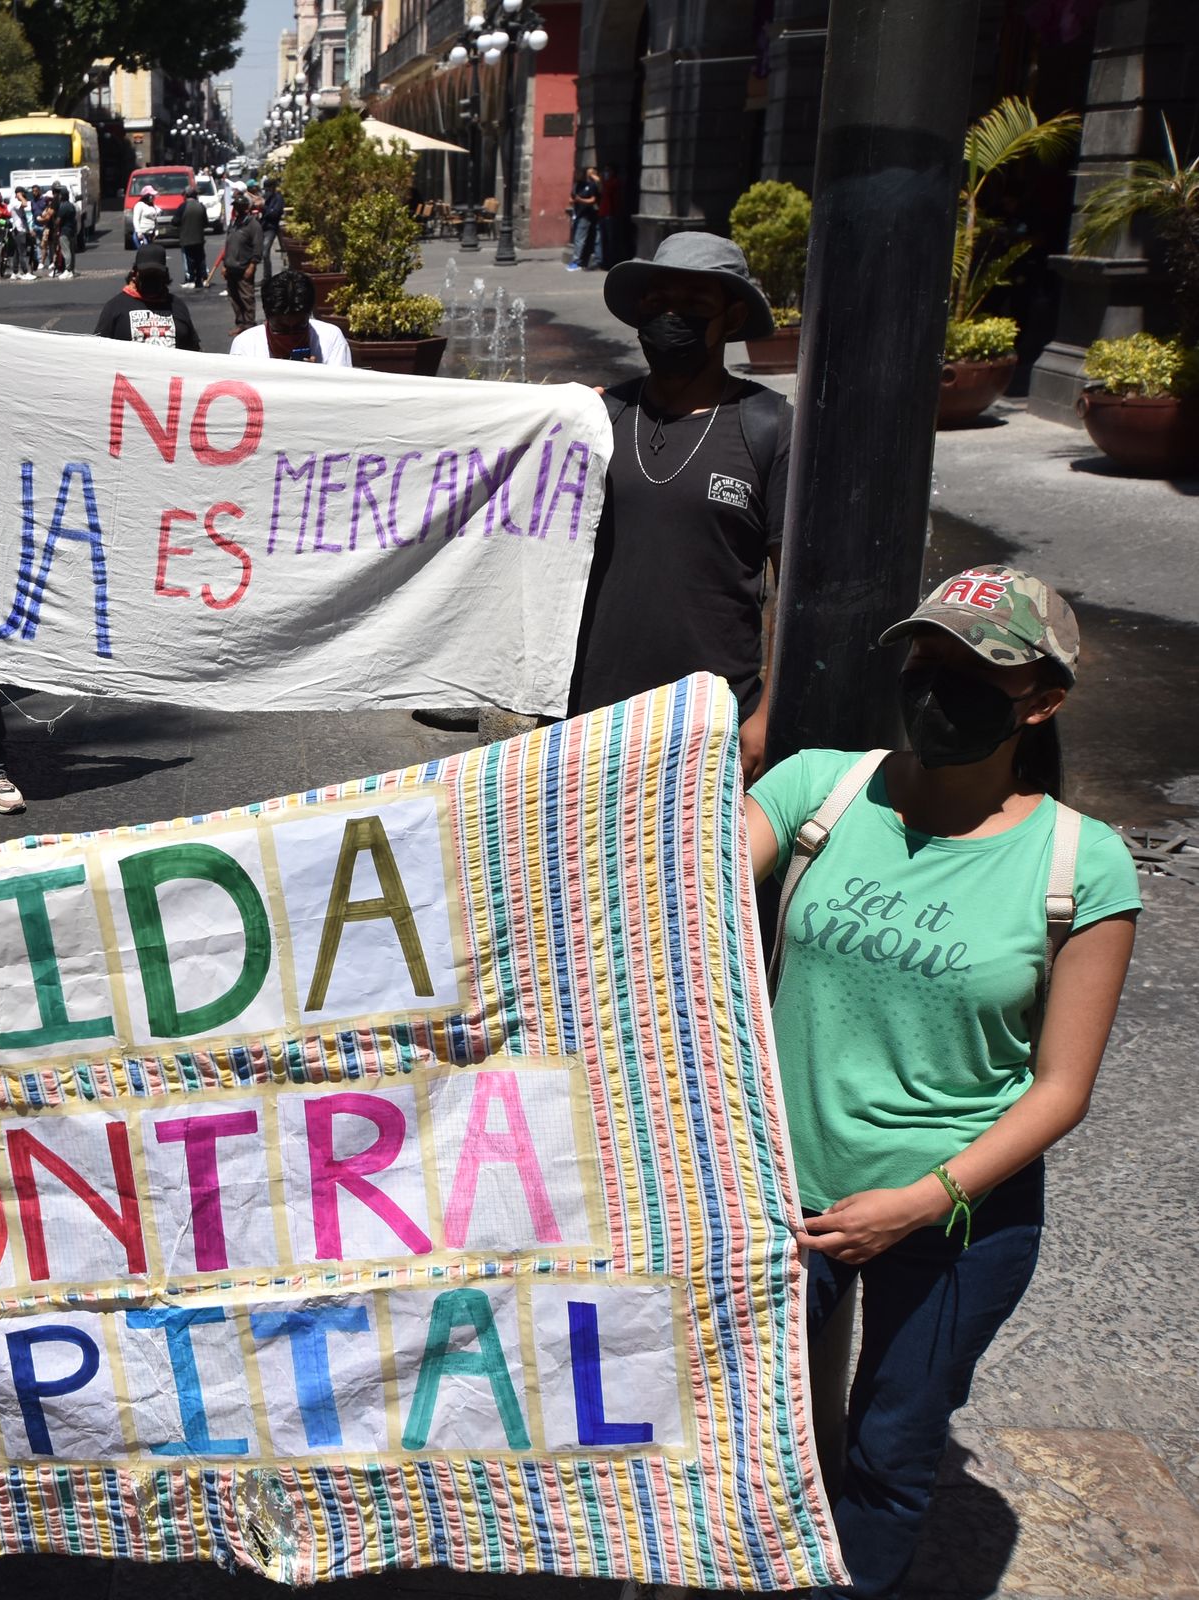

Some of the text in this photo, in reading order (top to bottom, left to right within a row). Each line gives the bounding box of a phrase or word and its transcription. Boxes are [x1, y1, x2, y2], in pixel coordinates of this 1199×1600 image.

[109, 372, 265, 467] NO
[712, 481, 722, 490] OFF
[722, 491, 739, 500] VANS
[154, 423, 589, 610] ES MERCANCÍA
[941, 580, 1007, 611] AE
[827, 877, 953, 932] Let it
